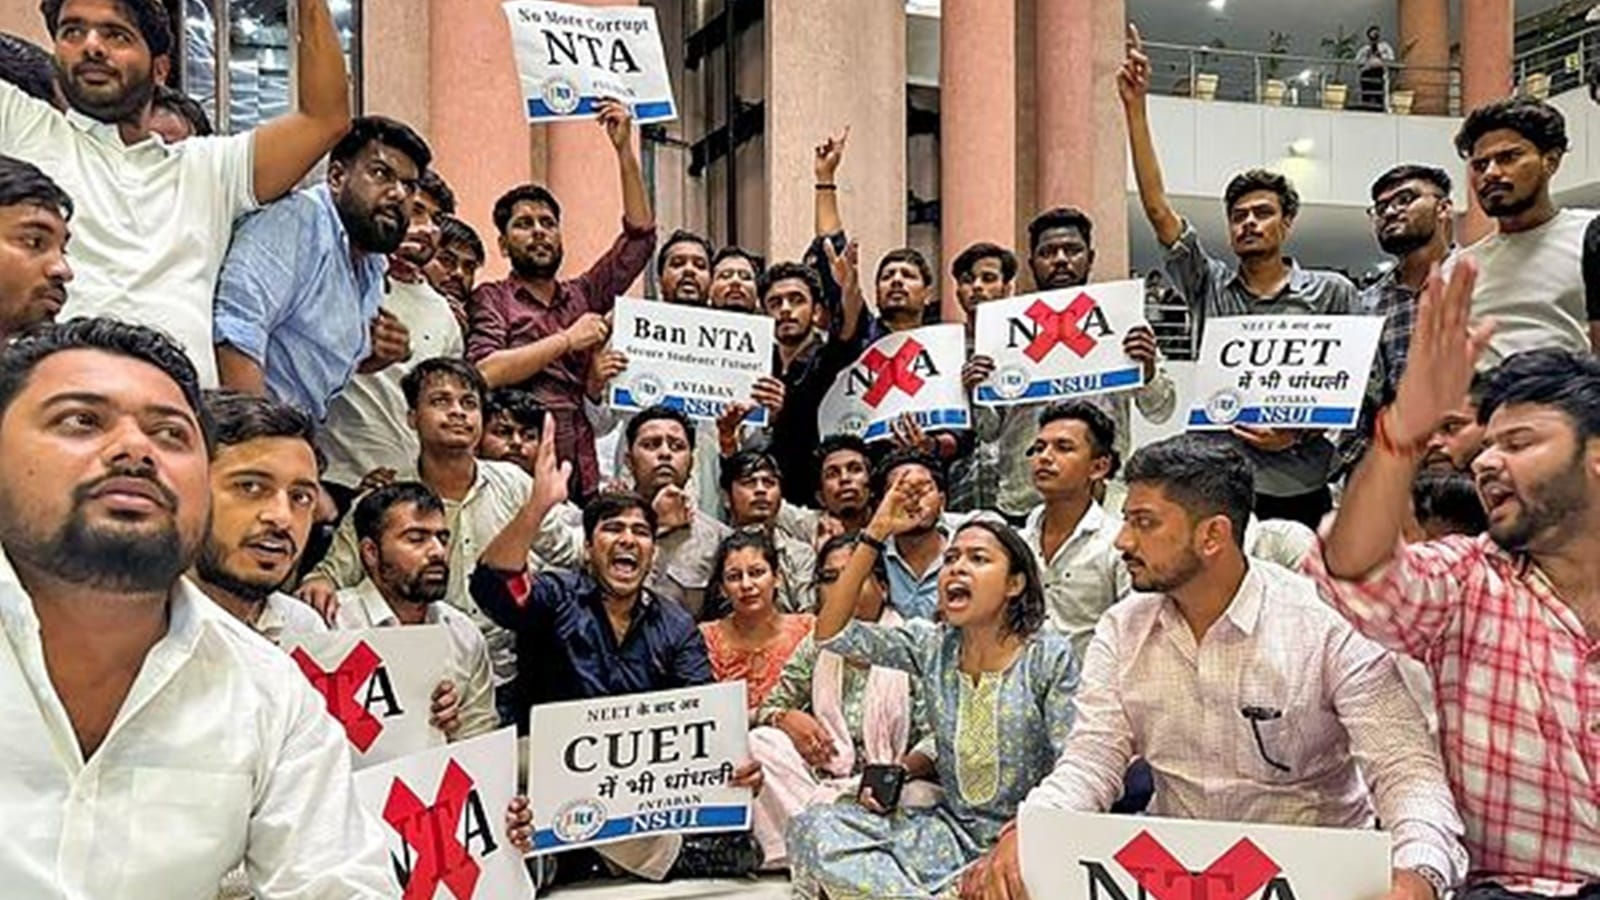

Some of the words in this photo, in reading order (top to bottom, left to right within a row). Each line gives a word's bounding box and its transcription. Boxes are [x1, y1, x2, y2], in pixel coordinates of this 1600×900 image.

[518, 8, 541, 23] No
[545, 10, 582, 27] More
[586, 17, 649, 35] Corrupt
[541, 29, 641, 74] NTA
[634, 317, 687, 345] Ban
[698, 325, 755, 353] NTA
[626, 345, 663, 359] Secure
[1219, 338, 1341, 368] CUET
[844, 350, 940, 396] NA
[1050, 374, 1102, 395] NSUI
[1238, 370, 1253, 390] में
[1259, 369, 1281, 390] भी
[684, 397, 727, 417] NSU
[1259, 406, 1313, 423] NSUI
[587, 705, 631, 722] NEET
[637, 702, 650, 716] के
[654, 701, 675, 715] बाद
[680, 698, 700, 711] अब
[564, 720, 716, 773] CUET
[599, 775, 618, 799] में
[626, 771, 655, 795] भी
[664, 761, 735, 790] धांधली
[631, 809, 700, 833] NSUI
